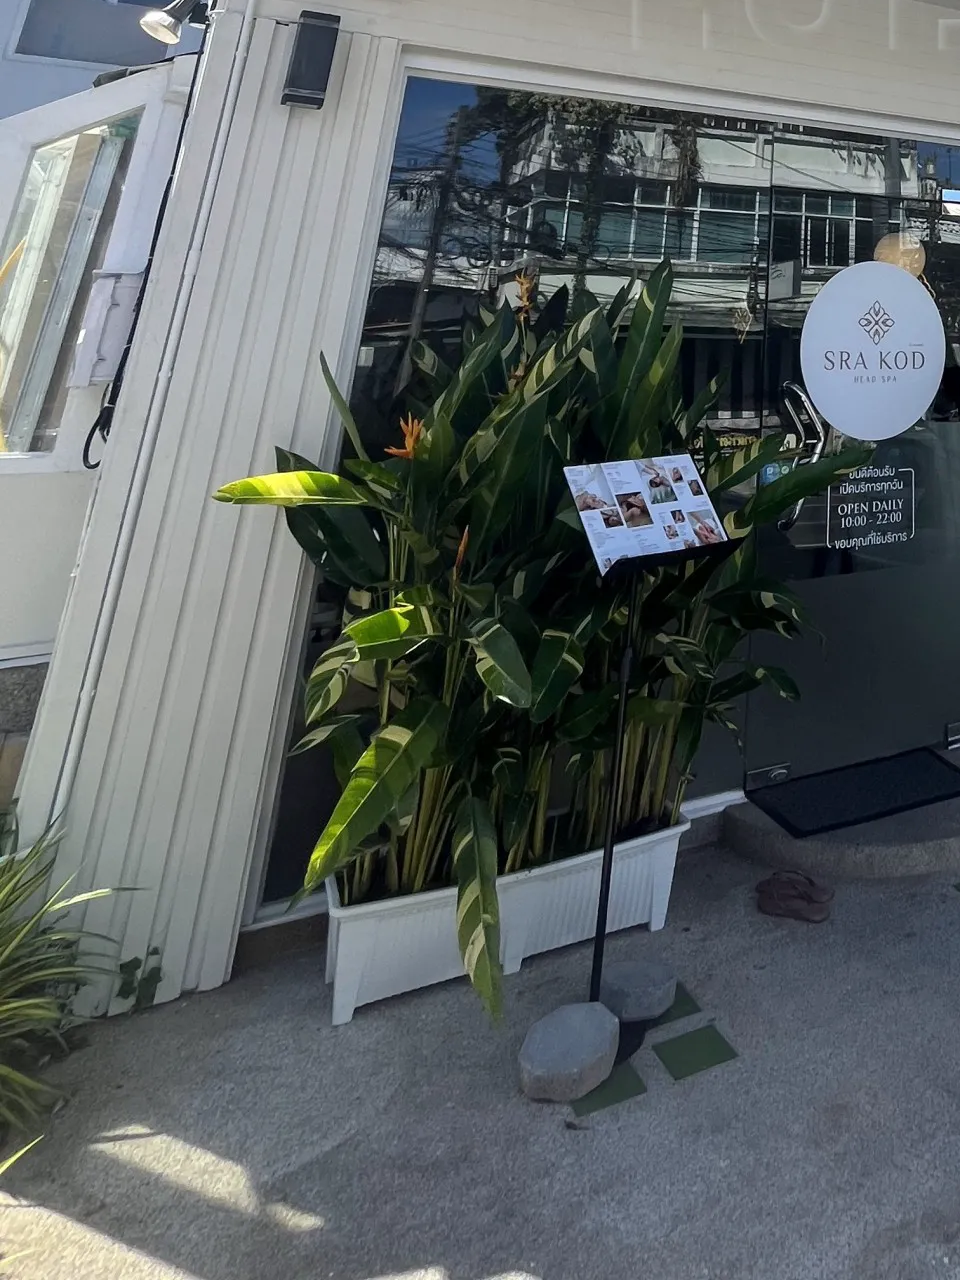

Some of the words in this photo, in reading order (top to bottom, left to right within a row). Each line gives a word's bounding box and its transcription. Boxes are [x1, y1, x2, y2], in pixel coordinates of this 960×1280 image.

[824, 350, 868, 371] SRA
[879, 350, 925, 371] KOD
[853, 375, 876, 384] HEAD
[882, 375, 897, 384] SPA
[840, 479, 903, 495] เปิดบริการทุกวัน
[838, 501, 869, 516] OPEN
[872, 498, 904, 513] DAILY
[840, 515, 867, 529] 10:00
[876, 511, 902, 525] 22:00
[834, 530, 908, 551] ขอบคุณที่ใช้บริการ
